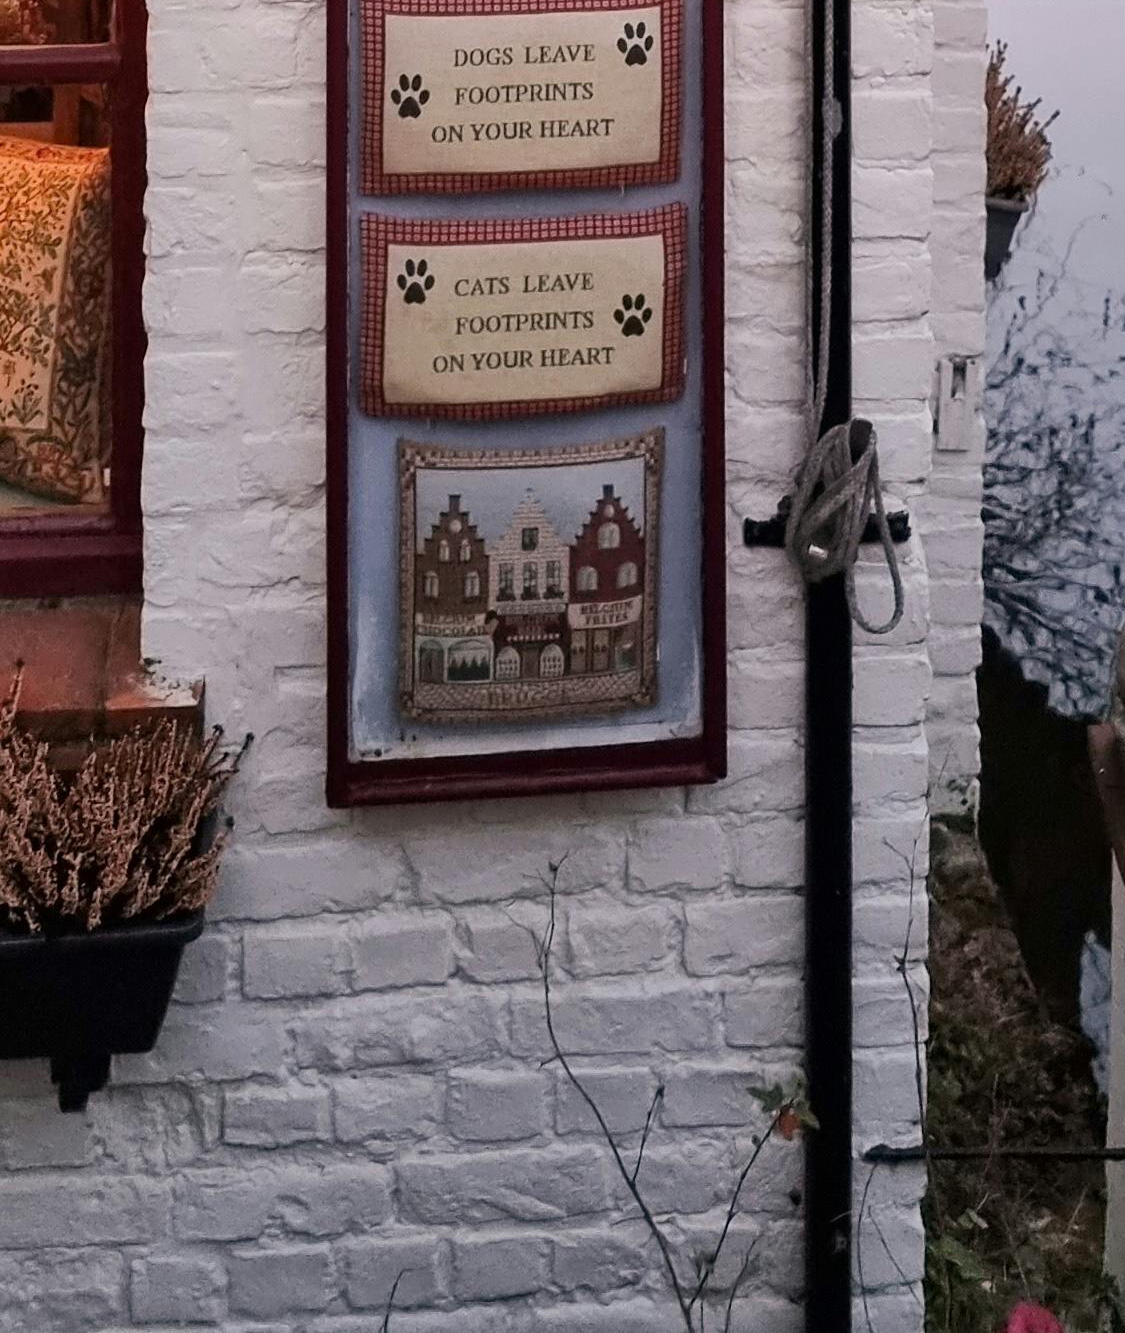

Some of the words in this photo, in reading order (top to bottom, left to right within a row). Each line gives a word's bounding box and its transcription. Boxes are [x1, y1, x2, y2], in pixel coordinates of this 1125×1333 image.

[453, 46, 514, 67] DOGS
[524, 43, 596, 64] LEAVE
[454, 81, 595, 105] FOOTPRINTS
[431, 124, 465, 143] ON
[470, 120, 533, 142] YOUR
[540, 118, 616, 138] HEART
[453, 276, 511, 297] CATS
[522, 272, 595, 294] LEAVE
[455, 310, 595, 335] FOOTPRINTS
[432, 353, 465, 374] ON
[470, 349, 534, 371] YOUR
[540, 346, 616, 368] HEART
